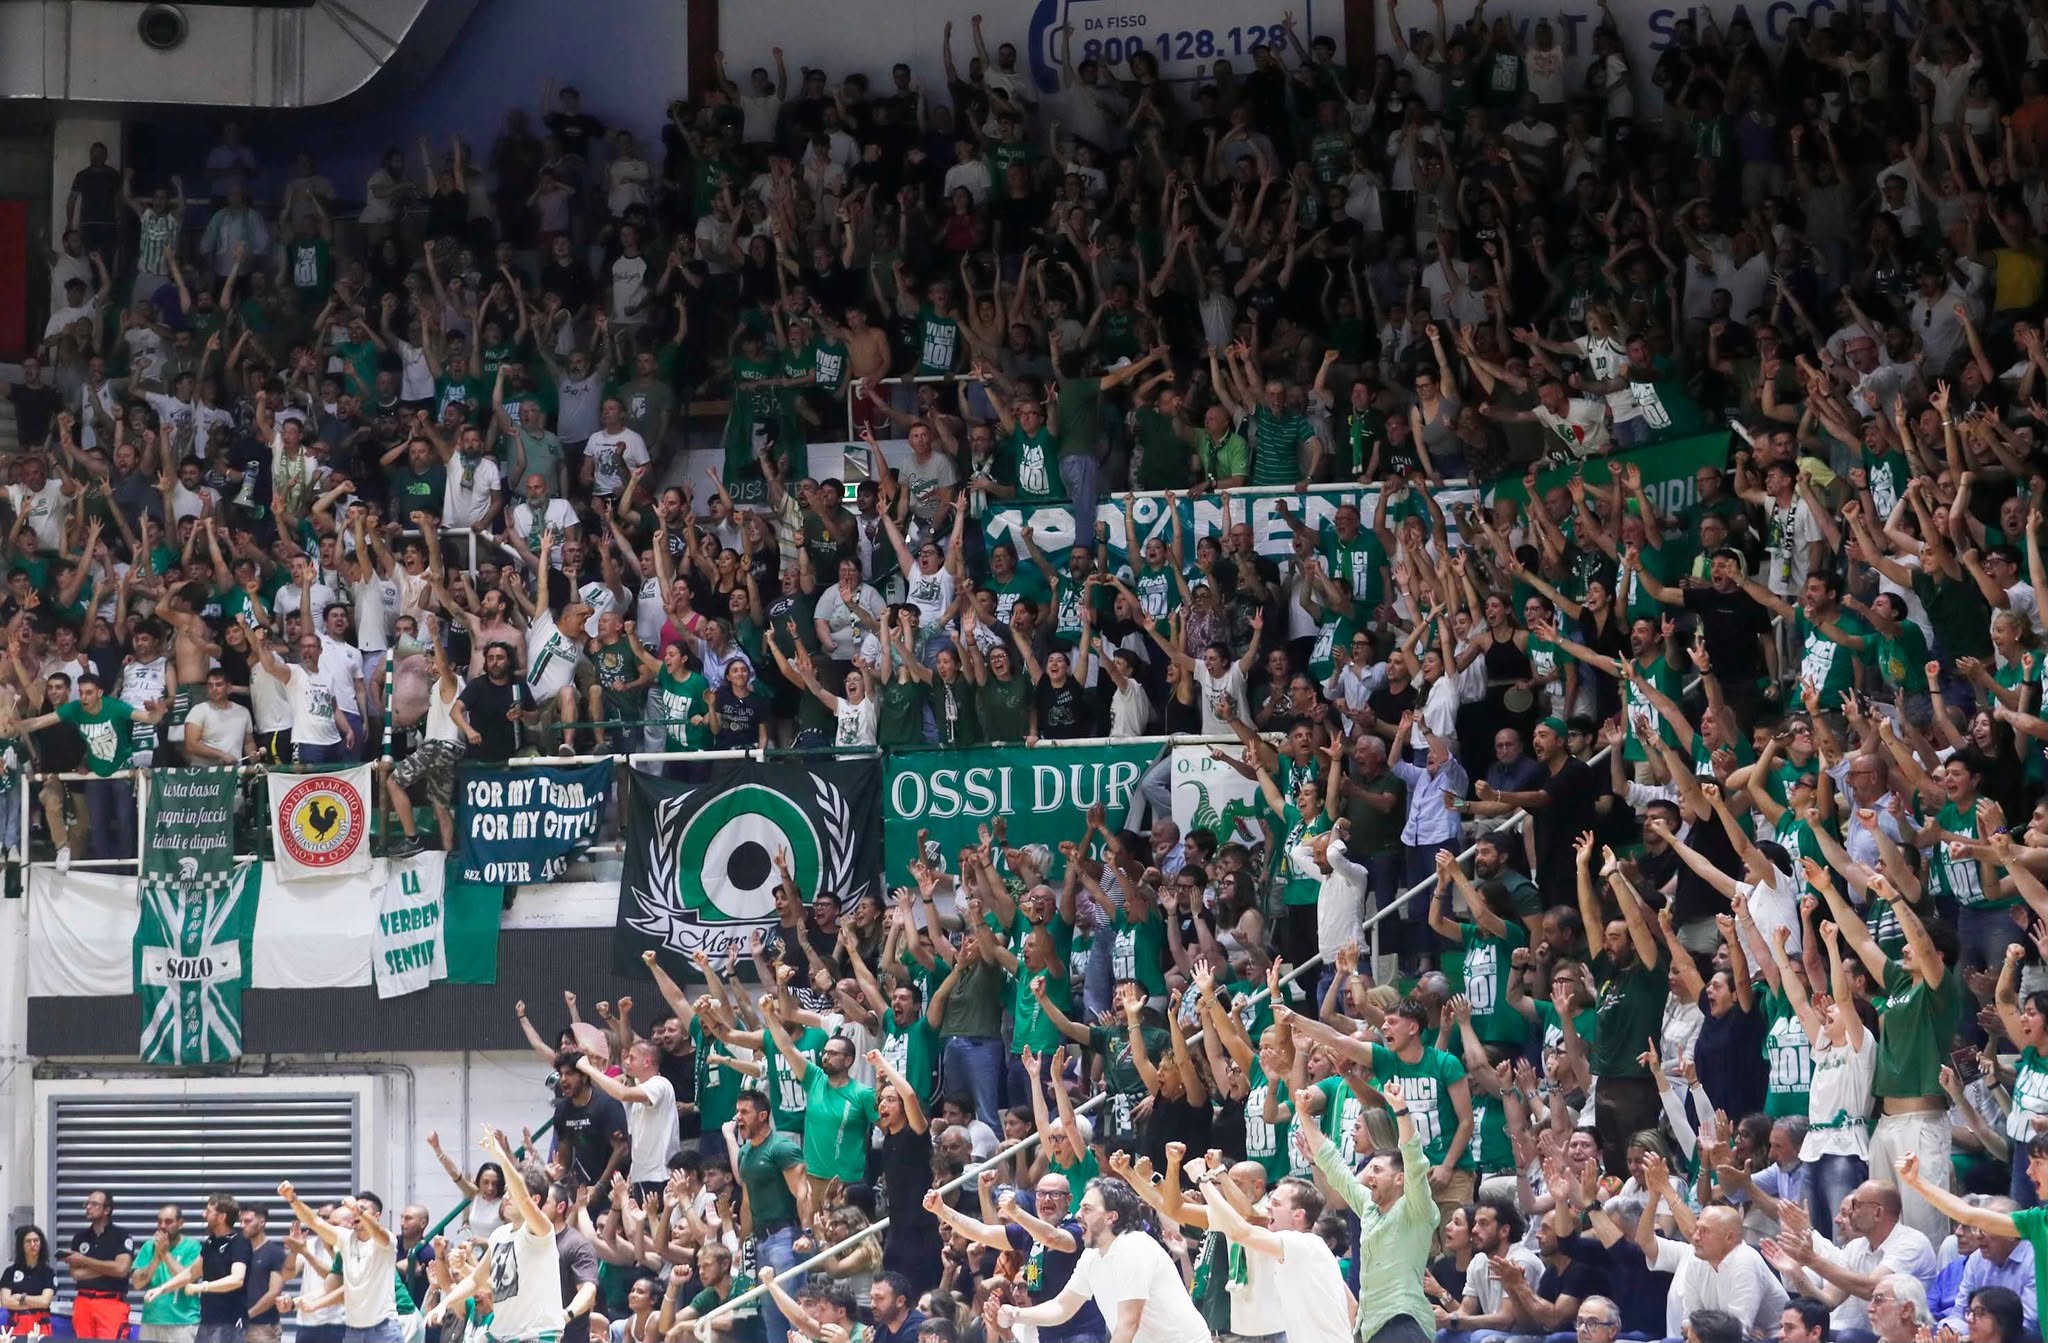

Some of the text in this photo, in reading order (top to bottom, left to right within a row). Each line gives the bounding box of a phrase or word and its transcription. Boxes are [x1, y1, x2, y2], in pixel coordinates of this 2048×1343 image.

[1085, 14, 1146, 31] DA FISSO
[1595, 357, 1607, 370] 10
[189, 781, 219, 798] bassa
[291, 784, 314, 806] DEL
[314, 781, 359, 812] MARCHIO
[508, 778, 536, 807] MY
[891, 760, 1155, 820] OSSI DUR
[186, 808, 198, 824] in
[471, 812, 509, 841] FOR
[512, 810, 541, 839] MY
[182, 838, 189, 849] e
[329, 812, 361, 860] STORICO
[401, 869, 421, 896] LA
[464, 868, 481, 881] SEZ.
[484, 861, 531, 883] OVER
[678, 927, 748, 954] Mens
[166, 956, 213, 980] SOLO
[1464, 975, 1496, 1009] NOI
[1770, 1047, 1810, 1085] NOI
